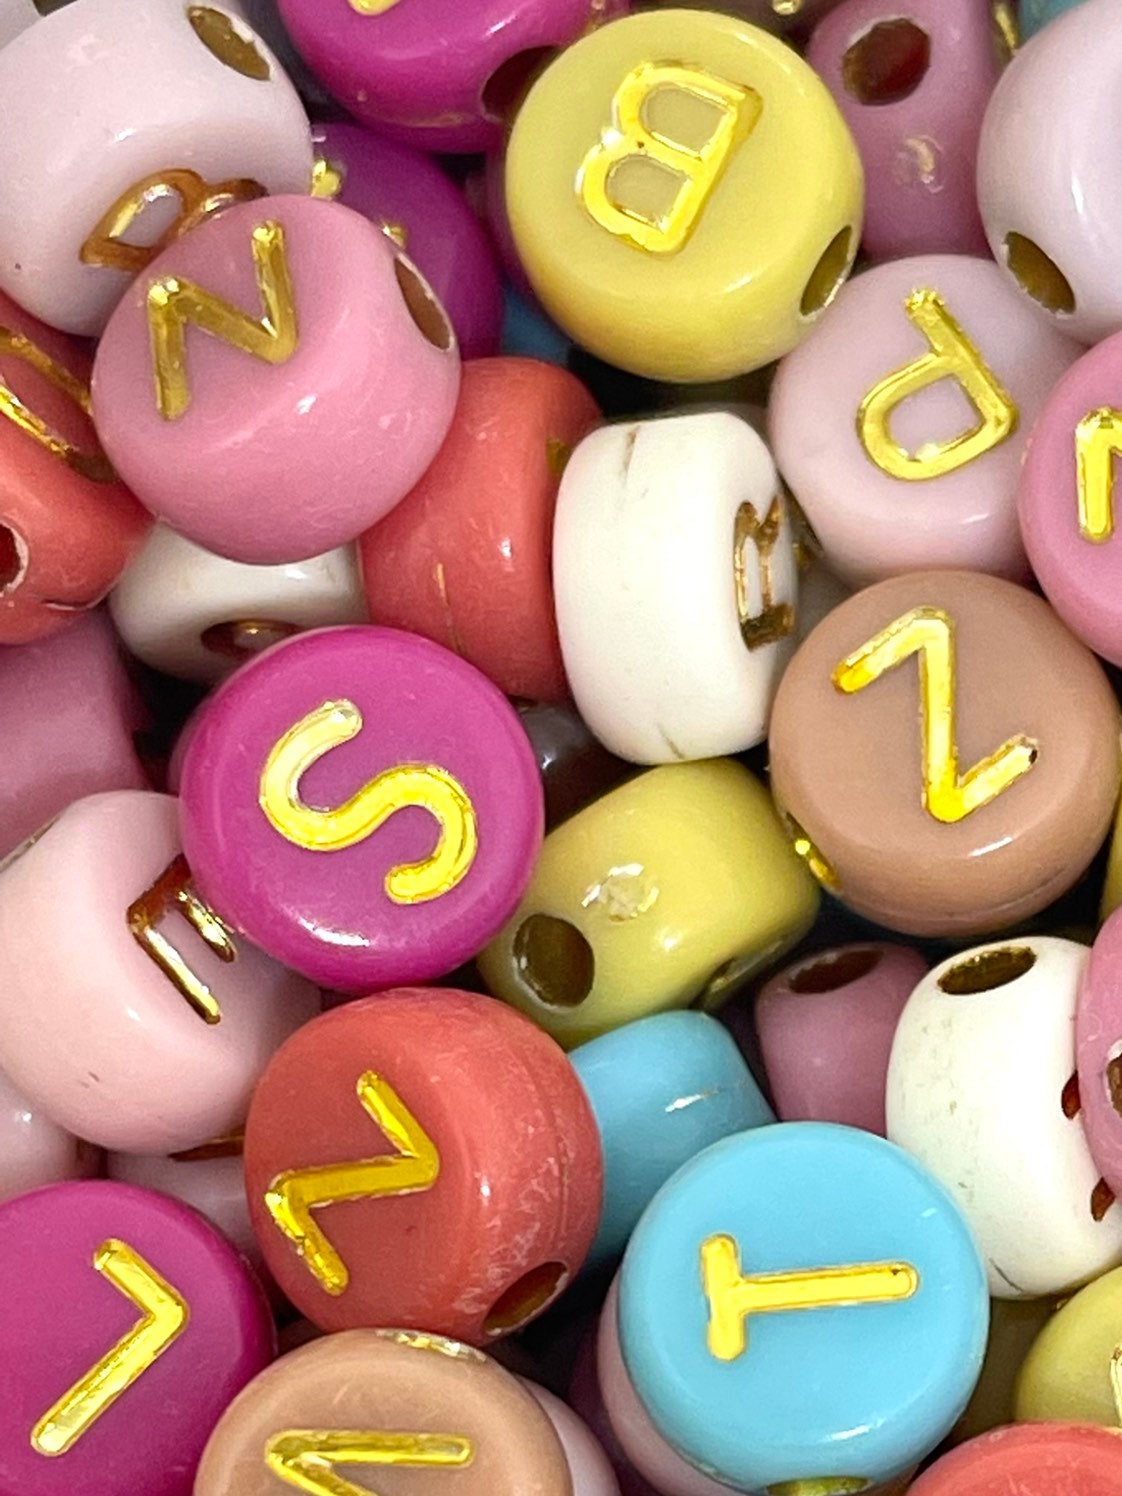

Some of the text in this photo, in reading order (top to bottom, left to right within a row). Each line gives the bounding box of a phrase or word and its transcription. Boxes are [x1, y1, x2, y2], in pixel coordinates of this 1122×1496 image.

[575, 59, 764, 256] B
[856, 288, 1017, 482] P
[258, 698, 478, 904] S
[700, 1233, 921, 1362] T
